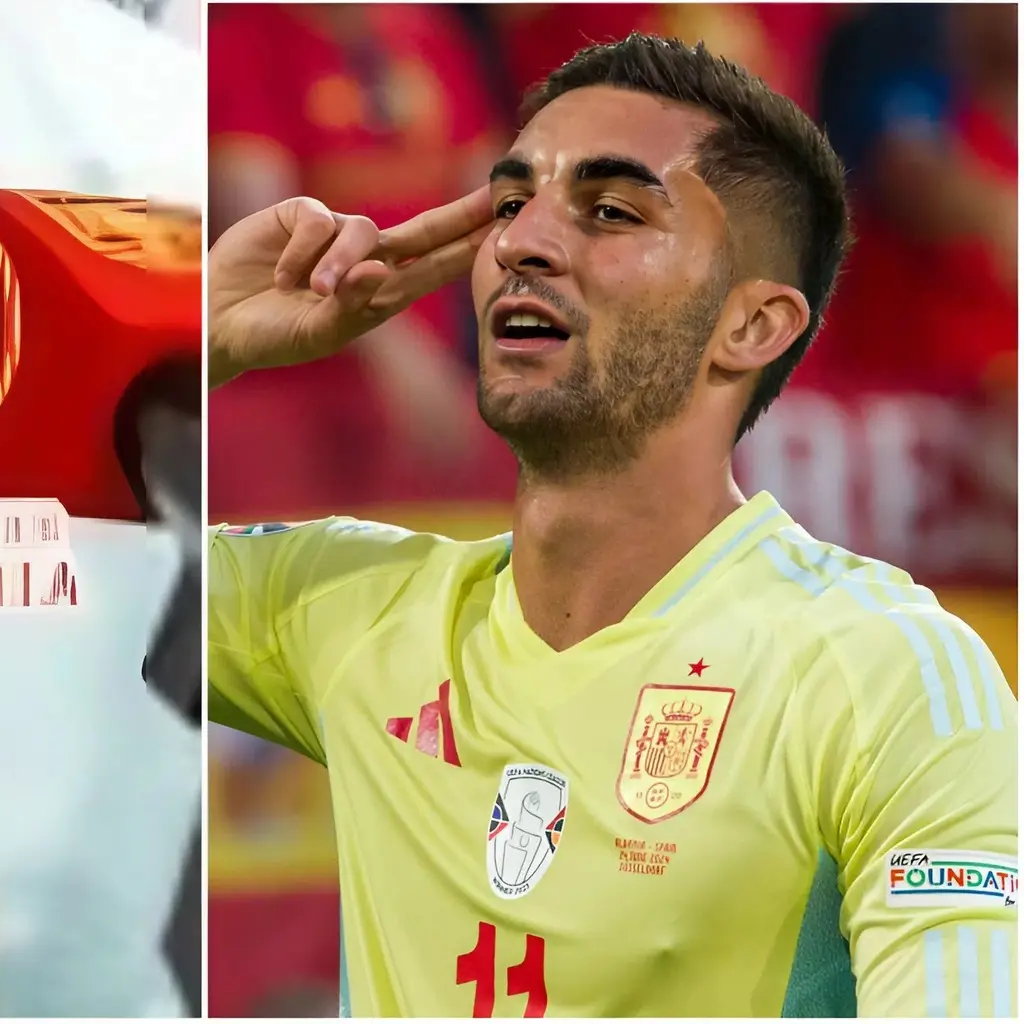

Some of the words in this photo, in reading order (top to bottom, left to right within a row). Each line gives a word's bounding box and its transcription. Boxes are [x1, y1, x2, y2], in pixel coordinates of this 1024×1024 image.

[890, 853, 929, 866] UEFA
[890, 868, 1018, 893] FOUNDATI
[456, 920, 548, 1018] 11
